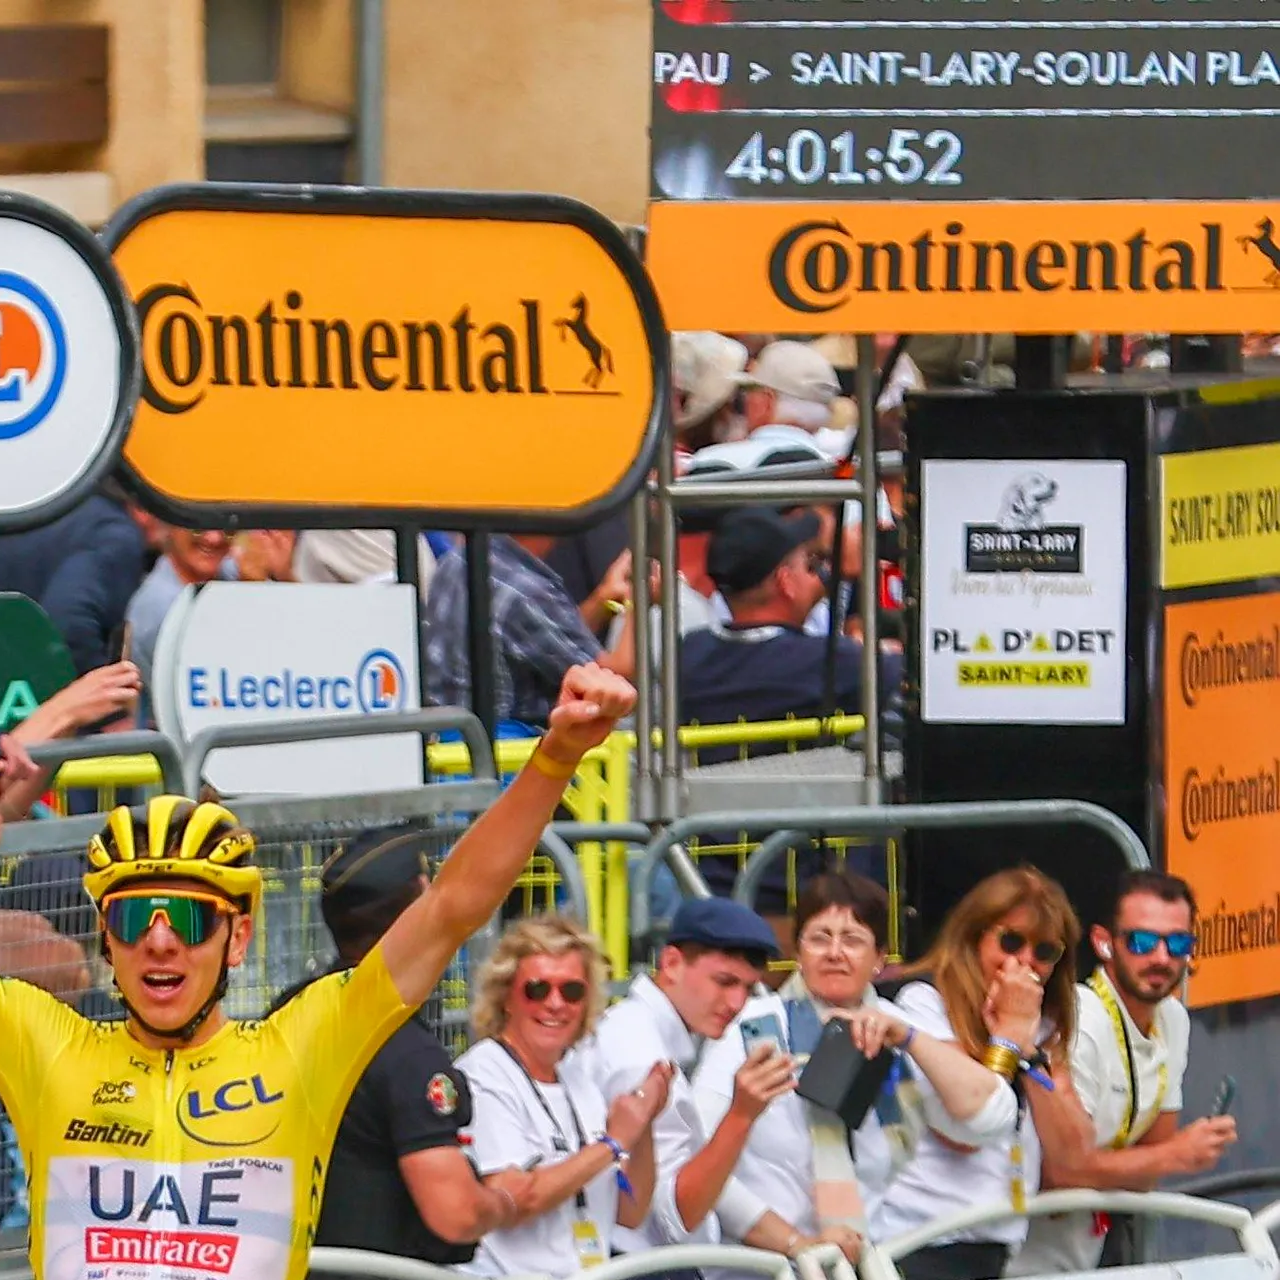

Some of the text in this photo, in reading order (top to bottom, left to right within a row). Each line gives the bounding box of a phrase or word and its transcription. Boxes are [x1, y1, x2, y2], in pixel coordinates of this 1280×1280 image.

[654, 51, 729, 85] PAU
[791, 50, 1197, 86] SAINT-LARY-SOULAN
[725, 128, 964, 186] 4:01:52
[768, 218, 1223, 314] Continental
[139, 282, 552, 415] Continental
[969, 532, 1077, 552] SAINT-LARY
[189, 667, 351, 708] E.Leclerc
[1189, 889, 1280, 977] ontinental
[187, 1073, 285, 1119] LCL
[64, 1118, 153, 1148] Santini
[88, 1165, 245, 1228] UAE
[90, 1231, 232, 1269] Emirates
